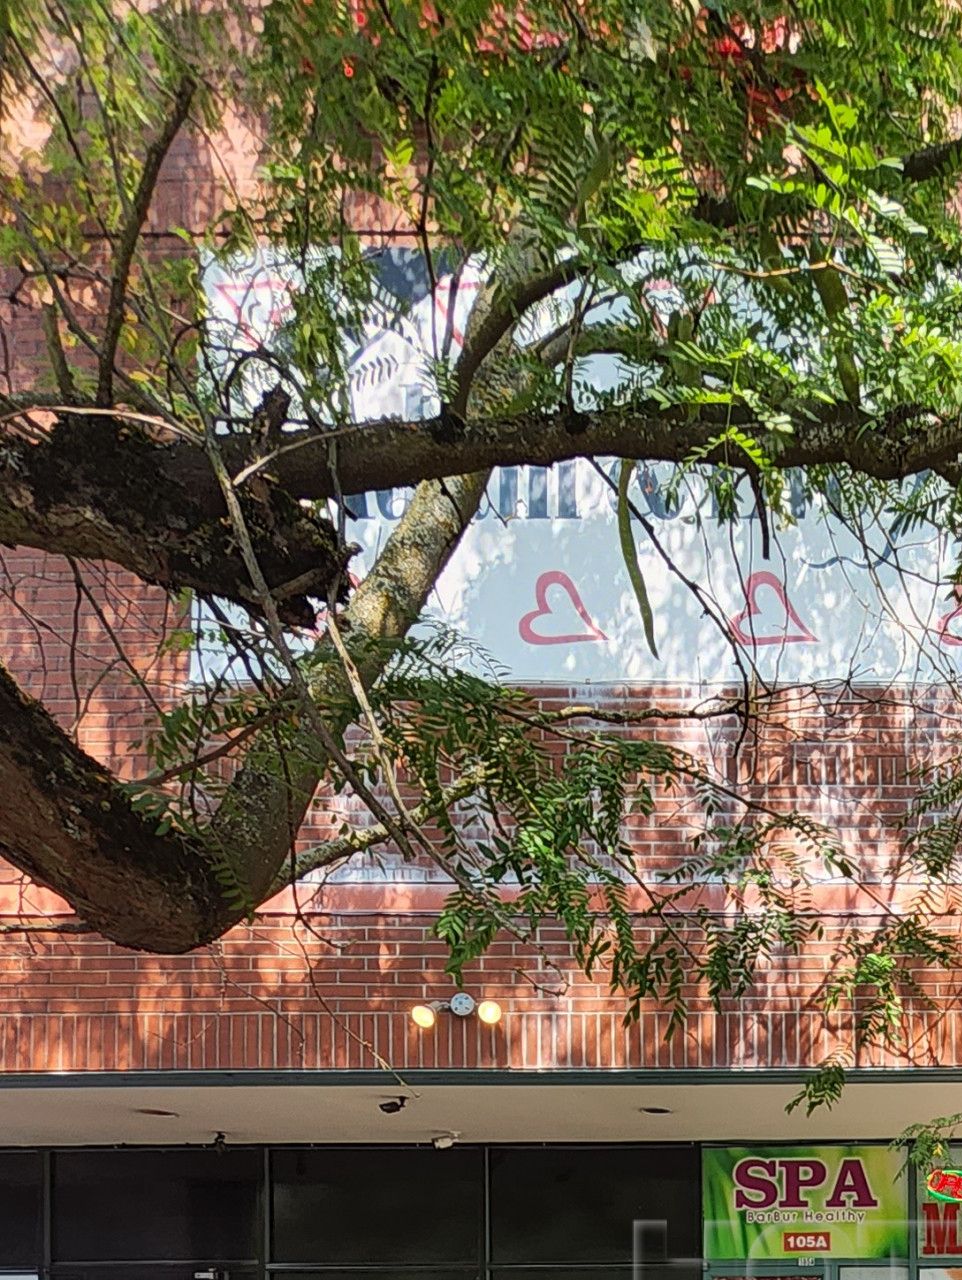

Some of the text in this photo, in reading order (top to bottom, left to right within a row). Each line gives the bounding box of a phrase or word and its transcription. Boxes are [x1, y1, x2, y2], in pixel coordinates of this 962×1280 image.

[735, 1158, 878, 1208] SPA
[746, 1212, 865, 1223] BarBur Healthy
[786, 1236, 827, 1248] 105A
